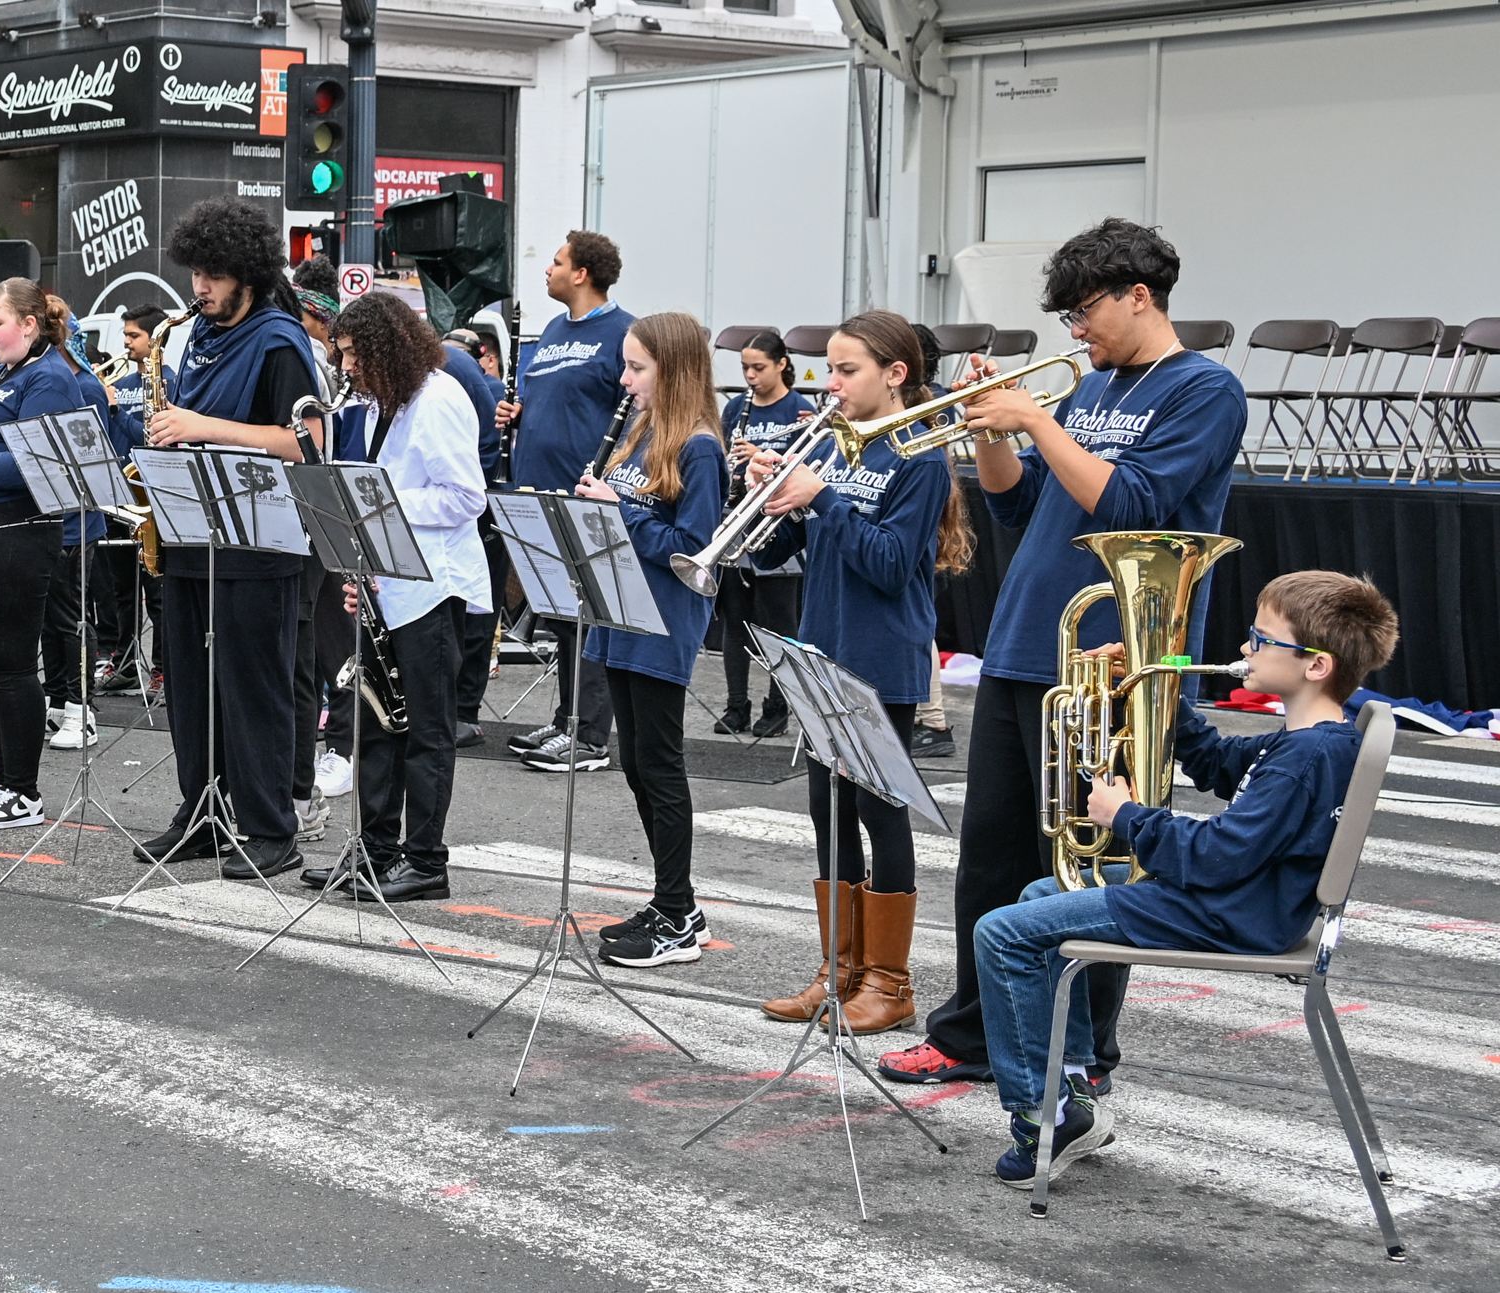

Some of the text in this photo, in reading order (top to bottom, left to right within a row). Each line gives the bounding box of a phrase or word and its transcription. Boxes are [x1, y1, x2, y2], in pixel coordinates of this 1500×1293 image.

[160, 75, 256, 114] Springfield
[263, 96, 287, 115] AT
[16, 130, 22, 138] C.
[23, 127, 49, 138] SULLIVAN
[49, 124, 78, 135] REGIONAL
[78, 121, 101, 131] VISITOR
[102, 118, 126, 128] CENTER
[232, 141, 281, 158] Information
[374, 169, 445, 185] NDCRAFTE
[237, 180, 281, 197] Brochures
[72, 178, 142, 241] VISITOR
[81, 215, 149, 277] CENTER
[744, 421, 764, 434] Tech
[1064, 407, 1155, 432] iTech Band
[609, 463, 651, 488] Tech Ban
[821, 464, 896, 489] Tech Band
[269, 494, 287, 502] Band
